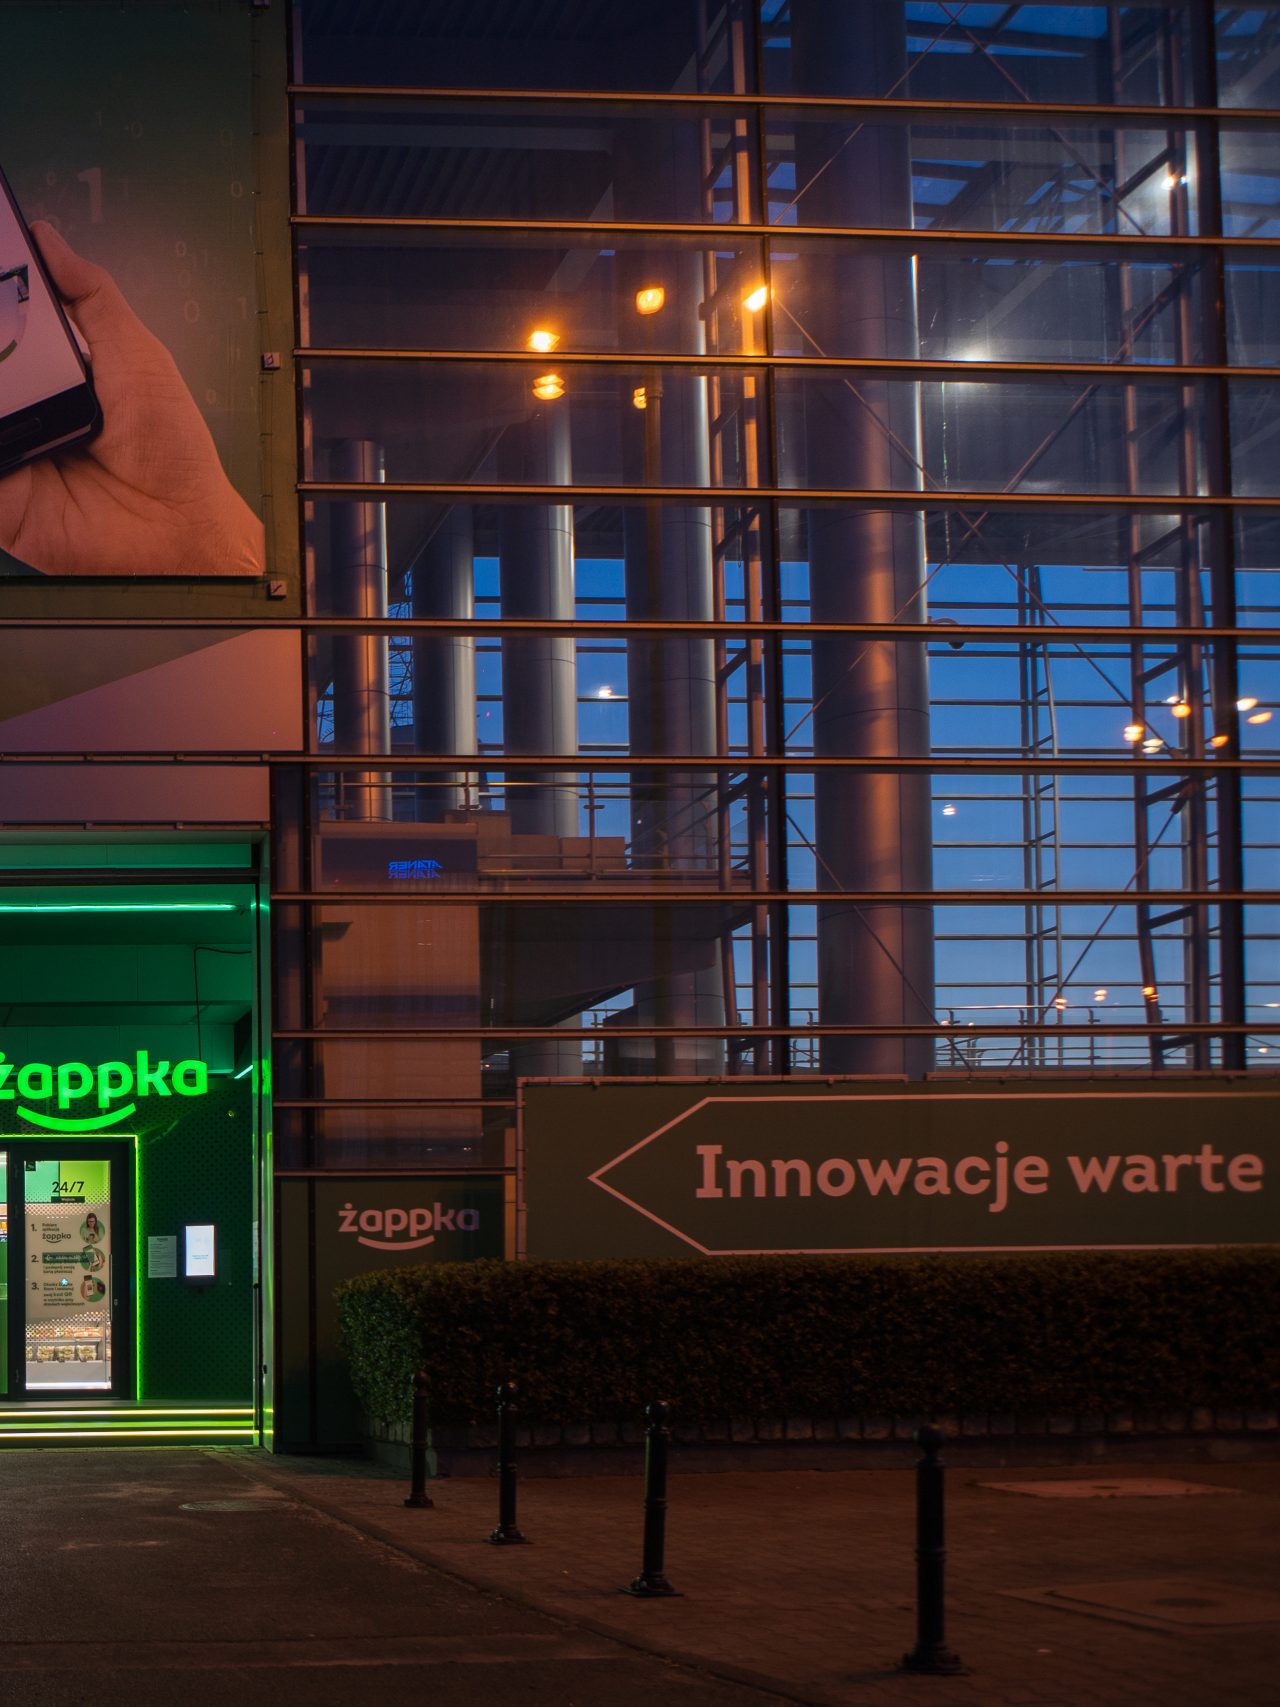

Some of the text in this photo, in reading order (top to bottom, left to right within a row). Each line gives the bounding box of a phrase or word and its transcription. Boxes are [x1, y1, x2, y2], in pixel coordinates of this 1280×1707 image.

[695, 1140, 1264, 1213] Innowacje warte
[51, 1181, 85, 1193] 24/7
[338, 1202, 480, 1238] żappka
[31, 1255, 39, 1263] 2.
[31, 1282, 40, 1291] 3.
